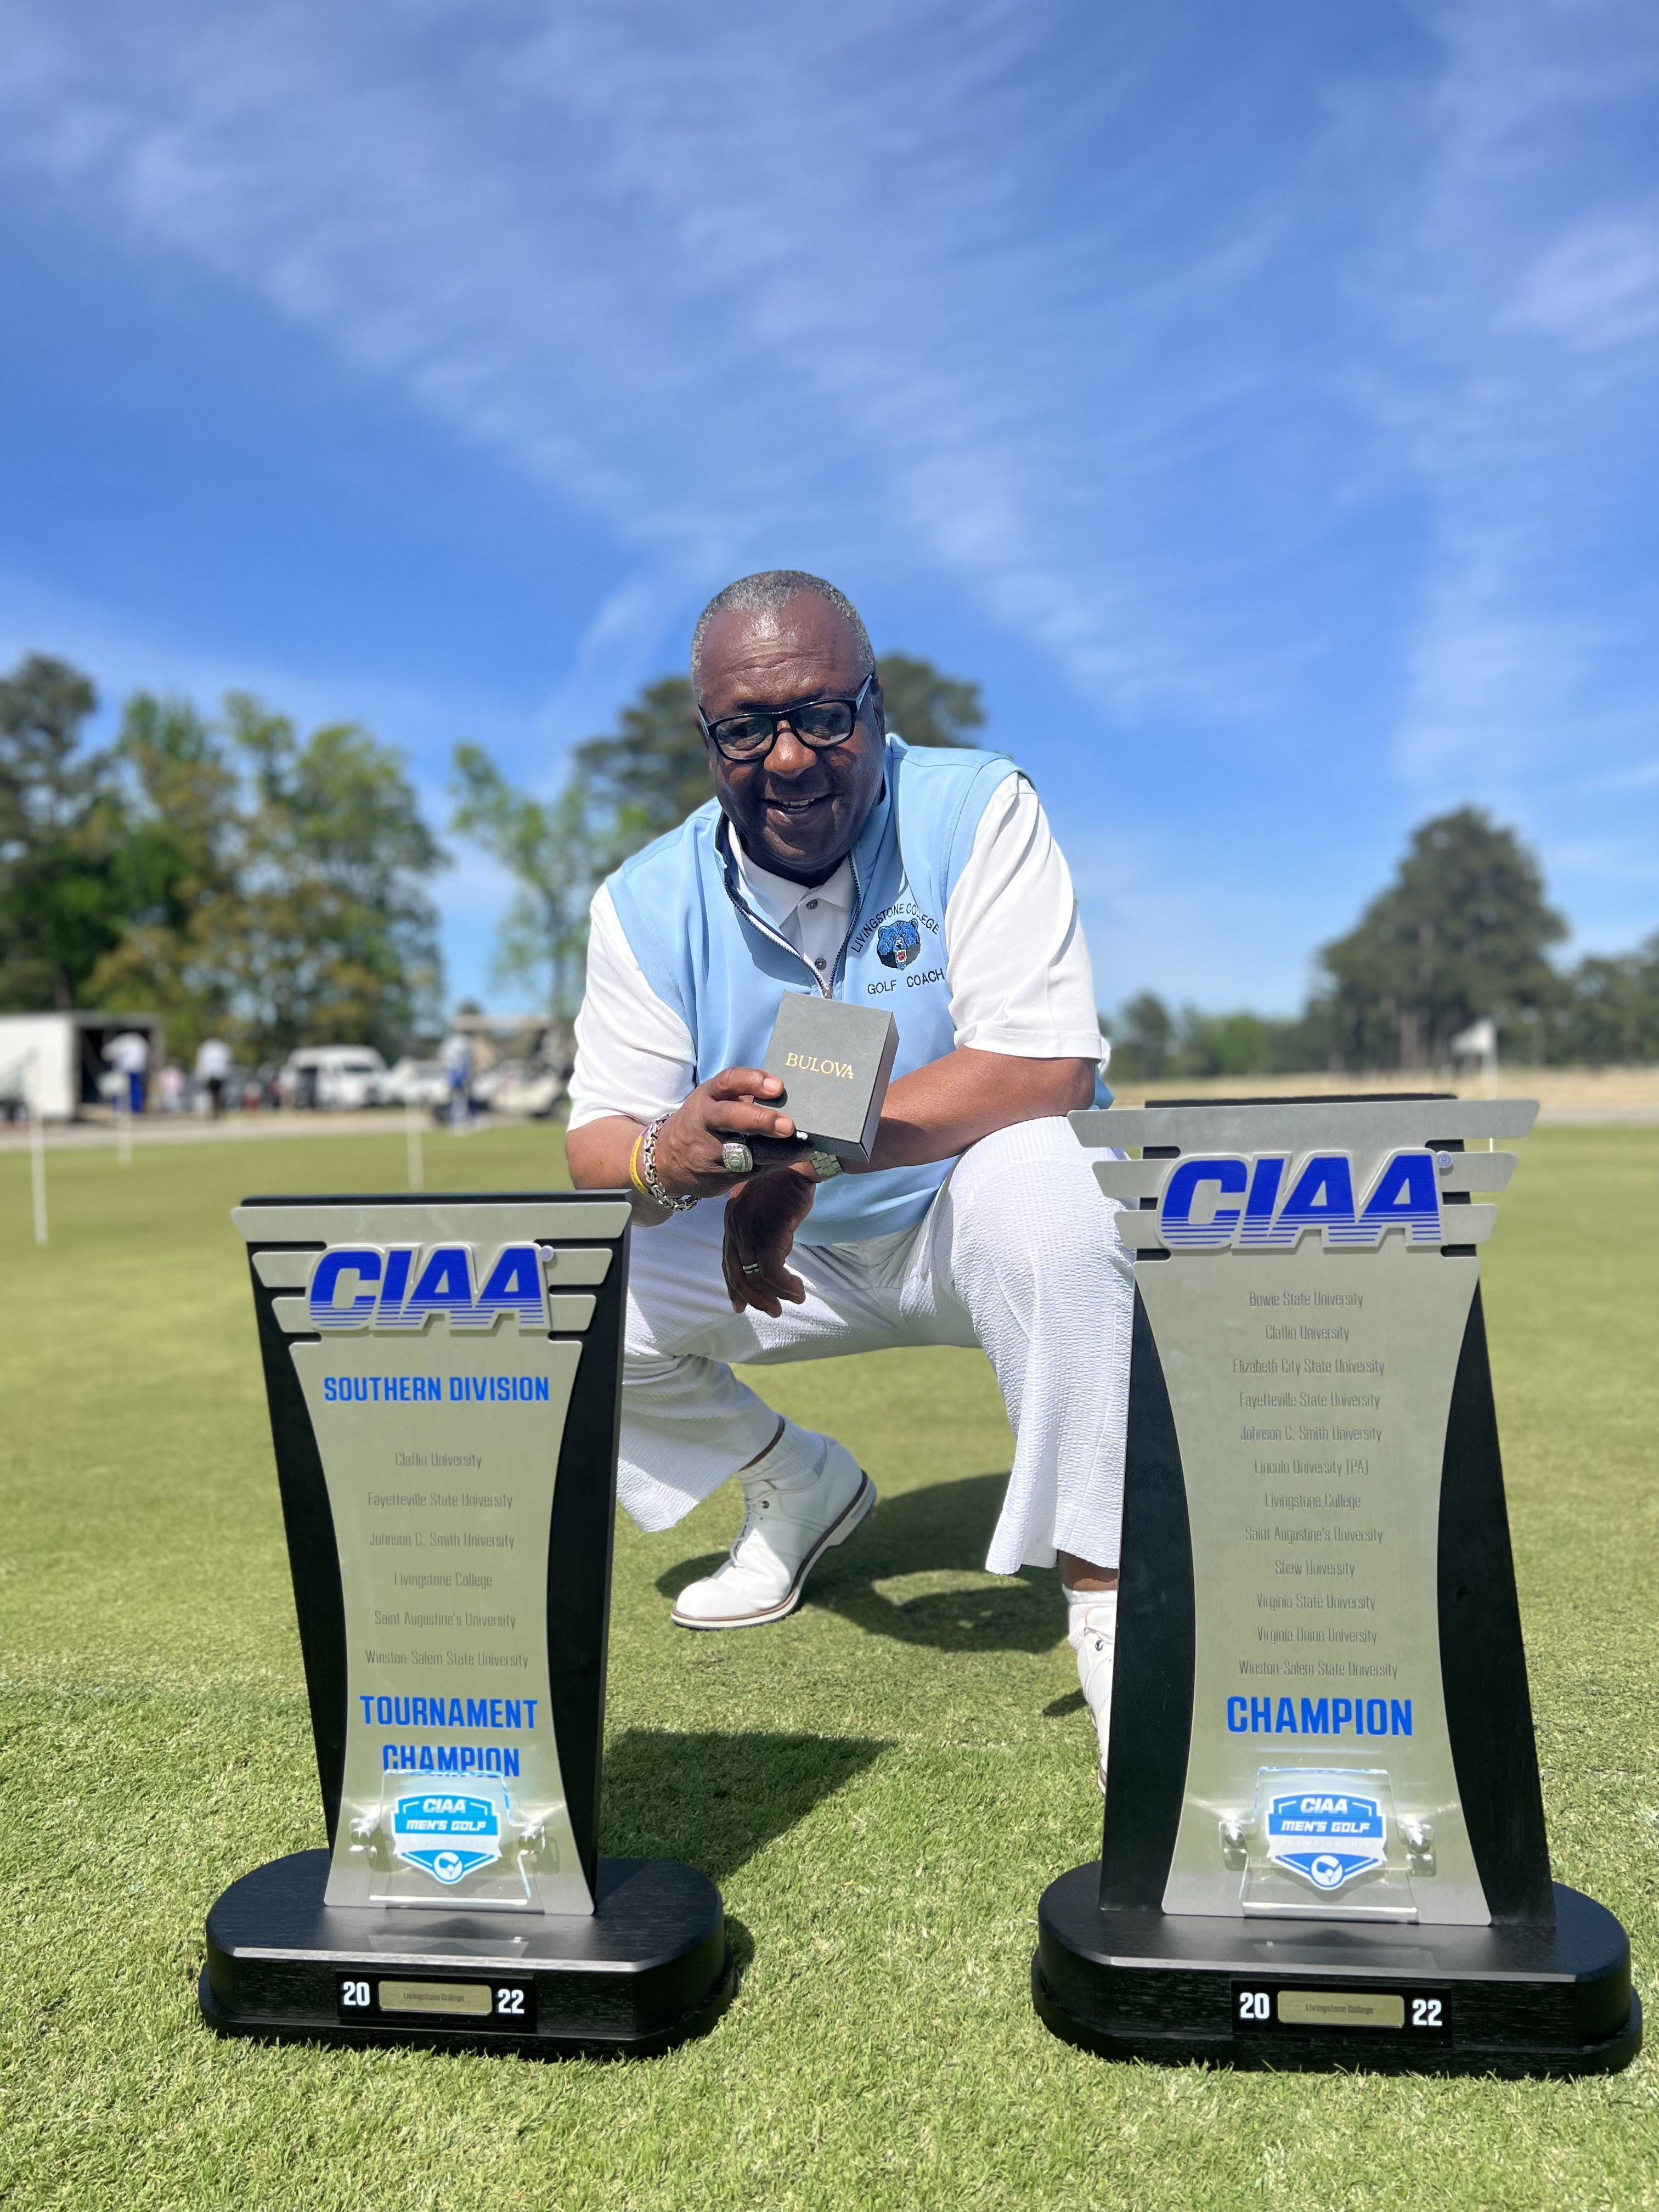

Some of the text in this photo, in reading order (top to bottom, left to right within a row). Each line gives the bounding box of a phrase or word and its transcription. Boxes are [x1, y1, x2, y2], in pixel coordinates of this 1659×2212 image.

[851, 903, 939, 953] LIVINGSTONE COLLEGE
[867, 968, 945, 994] GOLF COACH
[786, 1053, 854, 1080] BULOVA
[1161, 1154, 1442, 1245] CIAA
[309, 1248, 544, 1326] CIAA
[1250, 1291, 1363, 1308] Bowie State University
[1266, 1325, 1349, 1342] Claflin University
[1233, 1358, 1384, 1376] Elizabeth City State University
[323, 1376, 549, 1402] SOUTHERN DIVISION
[1240, 1392, 1380, 1409] Fayetteville State University
[1241, 1426, 1381, 1443] Johnson C. Smith University
[395, 1453, 481, 1469] Claflin University
[1255, 1459, 1289, 1474] Lincoln
[1294, 1460, 1342, 1477] University
[368, 1492, 512, 1510] Fayetteville State University
[1265, 1493, 1361, 1511] Livingstone College
[370, 1532, 411, 1546] Johnson
[430, 1532, 460, 1547] Smith
[464, 1533, 514, 1550] University
[1246, 1526, 1383, 1545] Saint Augustine's University
[1276, 1560, 1355, 1578] Shaw University
[394, 1572, 492, 1589] Livingstone College
[1257, 1593, 1375, 1612] Virginia State University
[375, 1611, 515, 1630] Saint Augustine's University
[1257, 1627, 1376, 1646] Virginia Union University
[365, 1650, 528, 1669] Winston-Salem State University
[1239, 1660, 1397, 1679] Winston-Salem State University
[360, 1696, 538, 1729] TOURNAMENT
[1227, 1696, 1412, 1736] CHAMPION
[383, 1745, 520, 1778] CHAMPION
[423, 1798, 466, 1814] CIAA
[1300, 1798, 1347, 1814] CIAA
[406, 1820, 486, 1831] MEN'S GOLF
[1282, 1820, 1370, 1833] MEN'S GOLF
[343, 1982, 370, 2006] 20
[403, 1991, 464, 2002] Livingstone College
[498, 1989, 524, 2014] 22
[1239, 1992, 1269, 2019] 20
[1306, 2003, 1374, 2015] Livingstone College
[1412, 1999, 1442, 2026] 22
